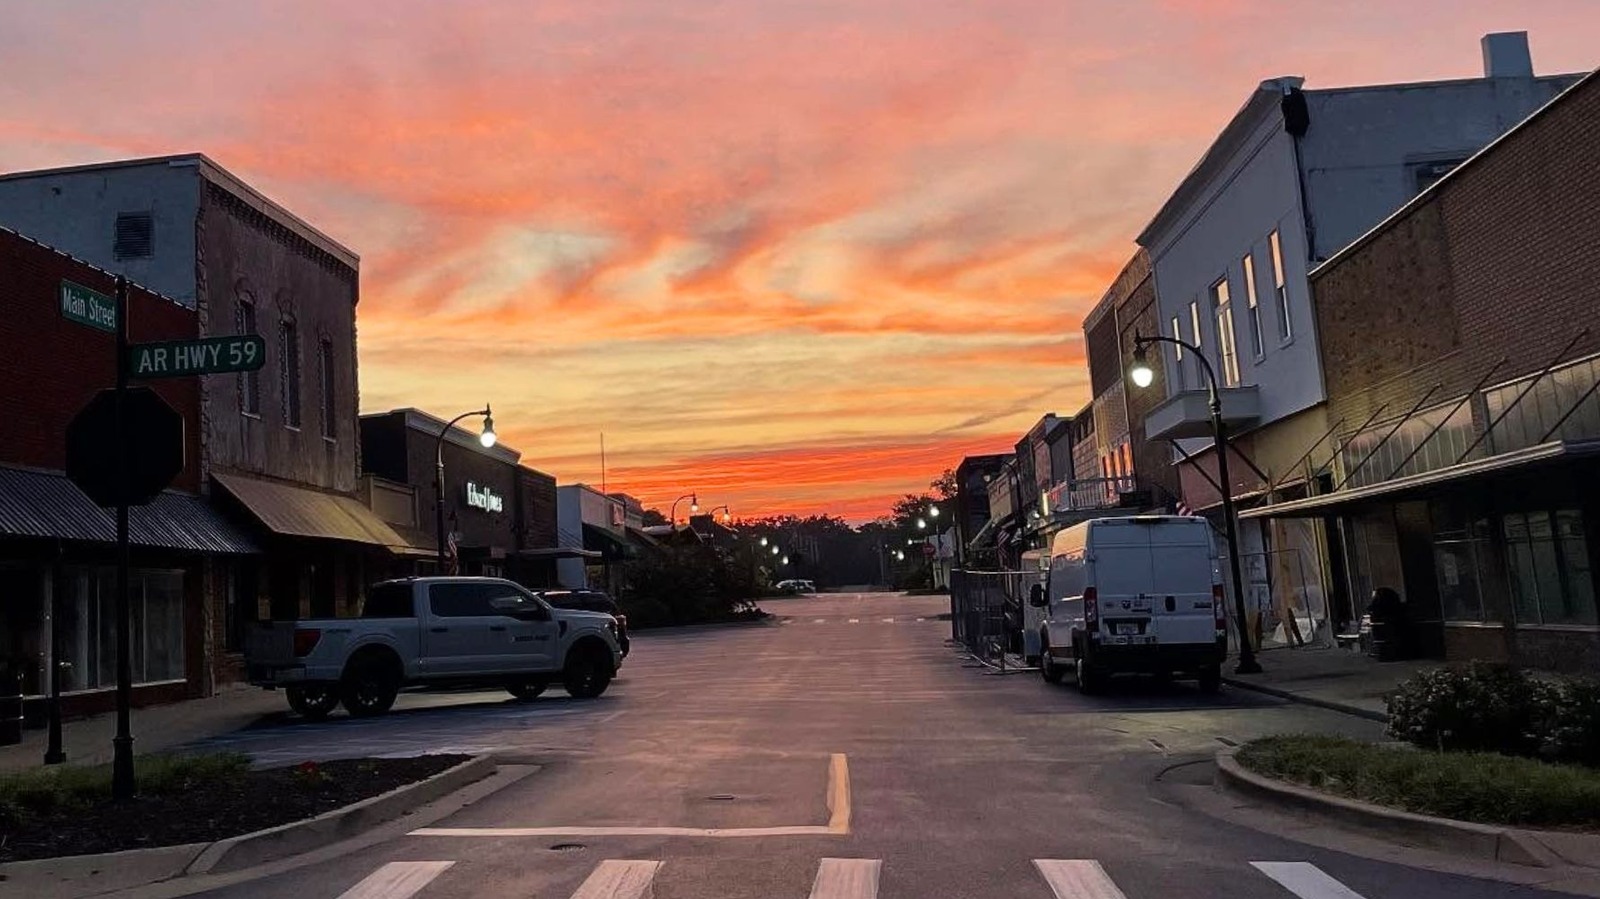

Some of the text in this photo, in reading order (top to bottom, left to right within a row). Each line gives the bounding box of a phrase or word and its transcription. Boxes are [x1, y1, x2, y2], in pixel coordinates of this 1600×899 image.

[63, 287, 116, 328] Main Street
[138, 341, 257, 373] AR HWY 59
